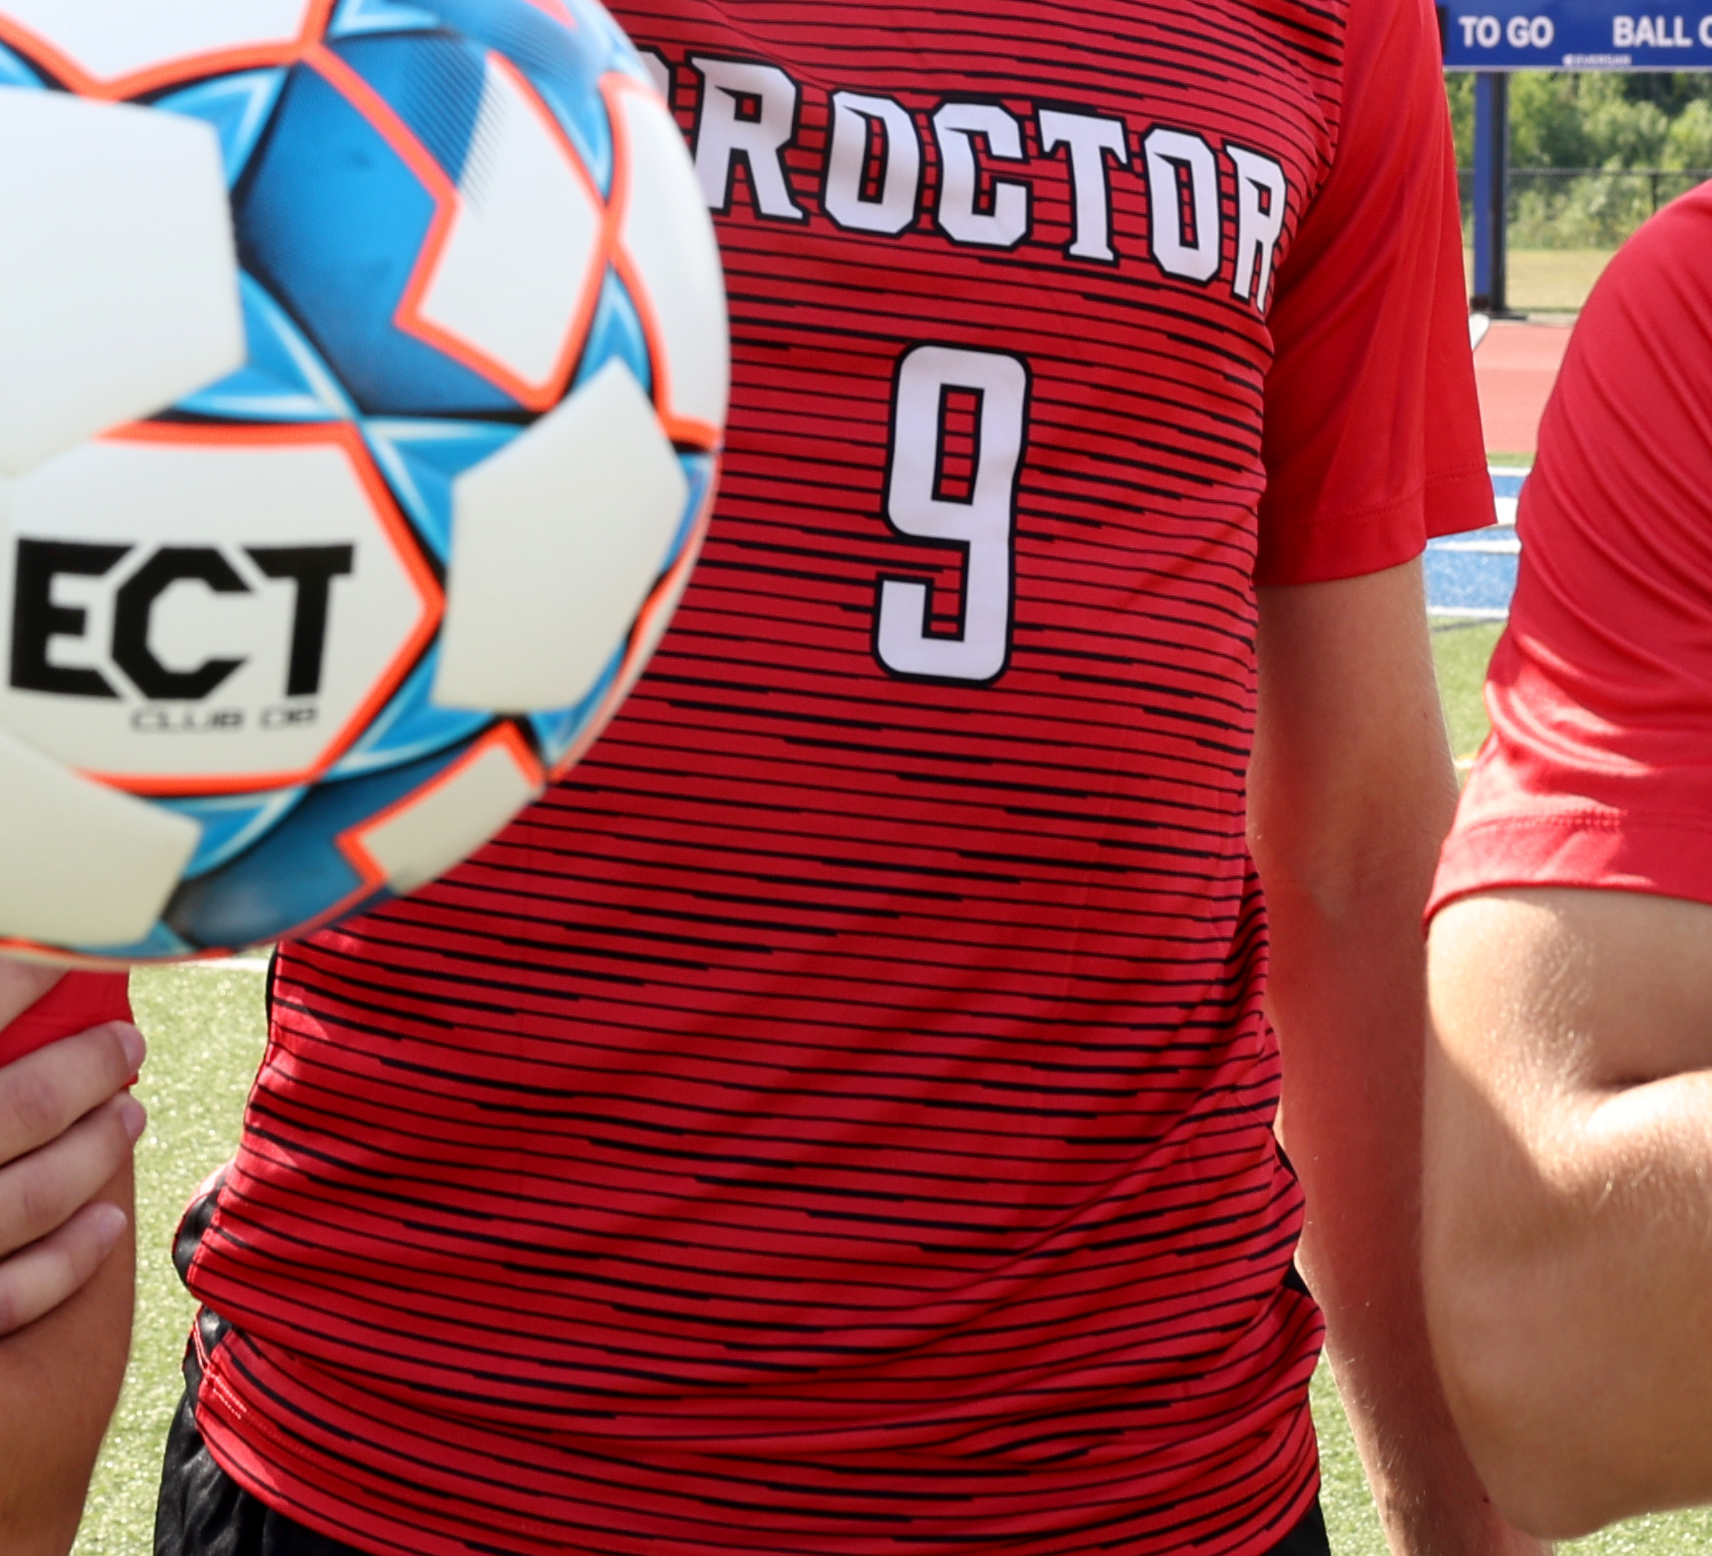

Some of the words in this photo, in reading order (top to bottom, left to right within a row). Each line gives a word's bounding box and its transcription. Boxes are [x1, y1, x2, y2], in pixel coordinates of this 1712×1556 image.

[1459, 16, 1500, 48] TO
[1506, 16, 1554, 48] GO
[1612, 15, 1693, 48] BALL
[637, 46, 1289, 312] ROCTOR
[875, 342, 1029, 684] 9
[130, 705, 245, 732] CLUB
